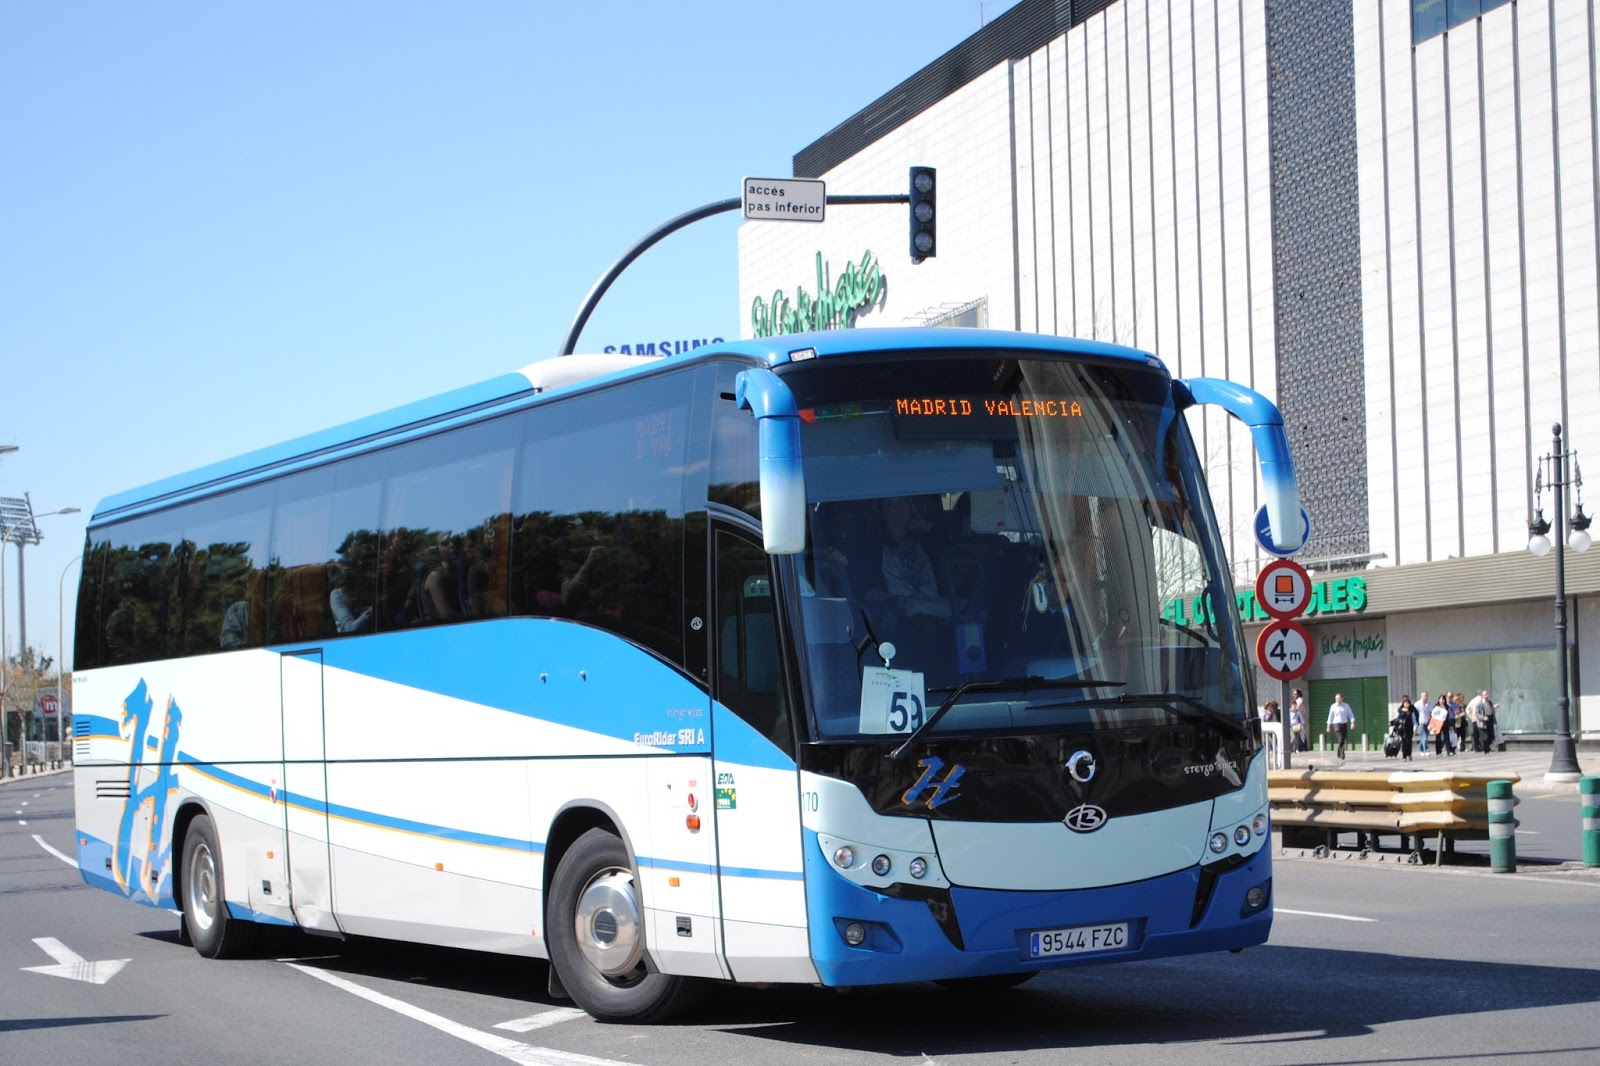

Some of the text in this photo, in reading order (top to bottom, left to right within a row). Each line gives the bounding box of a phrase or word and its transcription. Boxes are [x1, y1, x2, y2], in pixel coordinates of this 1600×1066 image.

[748, 202, 820, 214] pas inferior
[896, 399, 1082, 417] MADRID VALENCIA
[1270, 640, 1301, 661] 4 m
[634, 728, 705, 746] EuroRider SRI A
[1042, 927, 1123, 953] 9544 FZC
